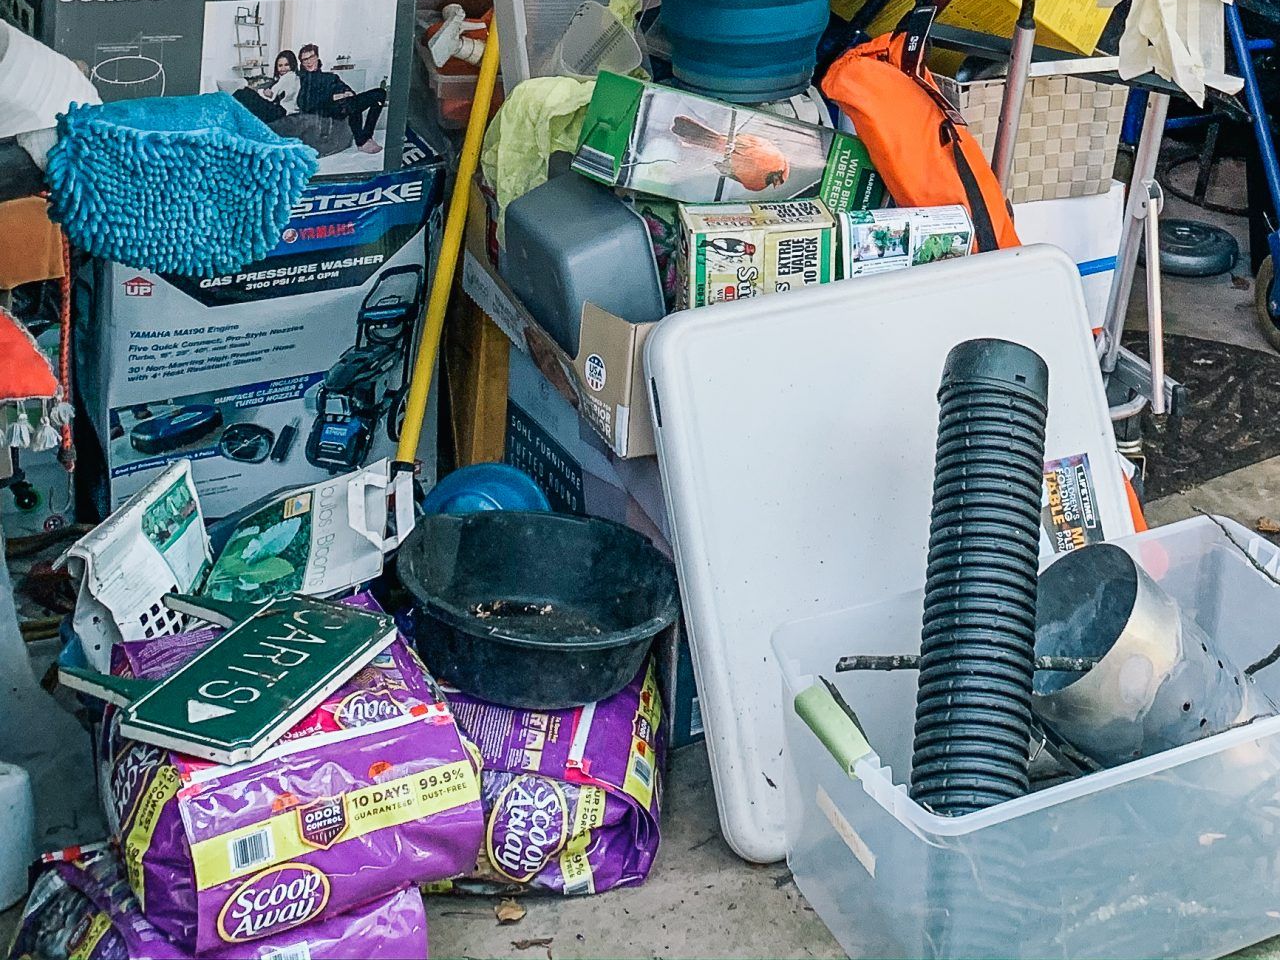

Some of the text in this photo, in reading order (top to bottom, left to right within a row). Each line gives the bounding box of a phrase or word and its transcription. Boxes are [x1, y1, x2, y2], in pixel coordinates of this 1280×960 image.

[836, 149, 851, 178] TUBE
[844, 158, 859, 188] WILD
[299, 223, 355, 240] YAMAHA
[777, 239, 791, 276] EXTRA
[791, 237, 805, 275] VALUE
[803, 236, 818, 285] 10 PACK
[200, 254, 384, 289] GAS PRESSURE WASHER
[245, 278, 270, 291] 3100
[272, 277, 290, 287] PSI
[318, 270, 340, 281] GPM
[126, 285, 152, 296] UP
[129, 323, 240, 339] YAMAHA MA190 Engine
[128, 344, 150, 353] Five
[151, 341, 178, 351] Quick
[127, 374, 148, 382] with
[269, 376, 309, 388] INCLUDES
[589, 363, 603, 378] USA
[214, 392, 254, 405] SURFACE
[256, 386, 296, 398] CLEANER
[235, 391, 300, 408] TURBO NOZZLE
[511, 414, 532, 443] SOHL
[535, 437, 581, 490] FURNITURE
[511, 435, 544, 478] TUFTED
[549, 470, 577, 511] ROUND
[1044, 471, 1066, 526] TABLE
[1056, 467, 1073, 522] FOLDING
[1063, 467, 1080, 520] CHILDREN'S
[1077, 471, 1093, 522] LIFETIME
[419, 767, 465, 790] 99.9%
[422, 782, 467, 802] DUST-FREE
[144, 784, 170, 833] LOWEST
[352, 784, 411, 809] 10 DAYS
[304, 805, 341, 824] ODOR
[306, 815, 343, 831] CONTROL
[495, 784, 535, 871] Away
[525, 786, 561, 873] Scoop
[232, 872, 321, 919] Scoop
[231, 897, 314, 939] Away
